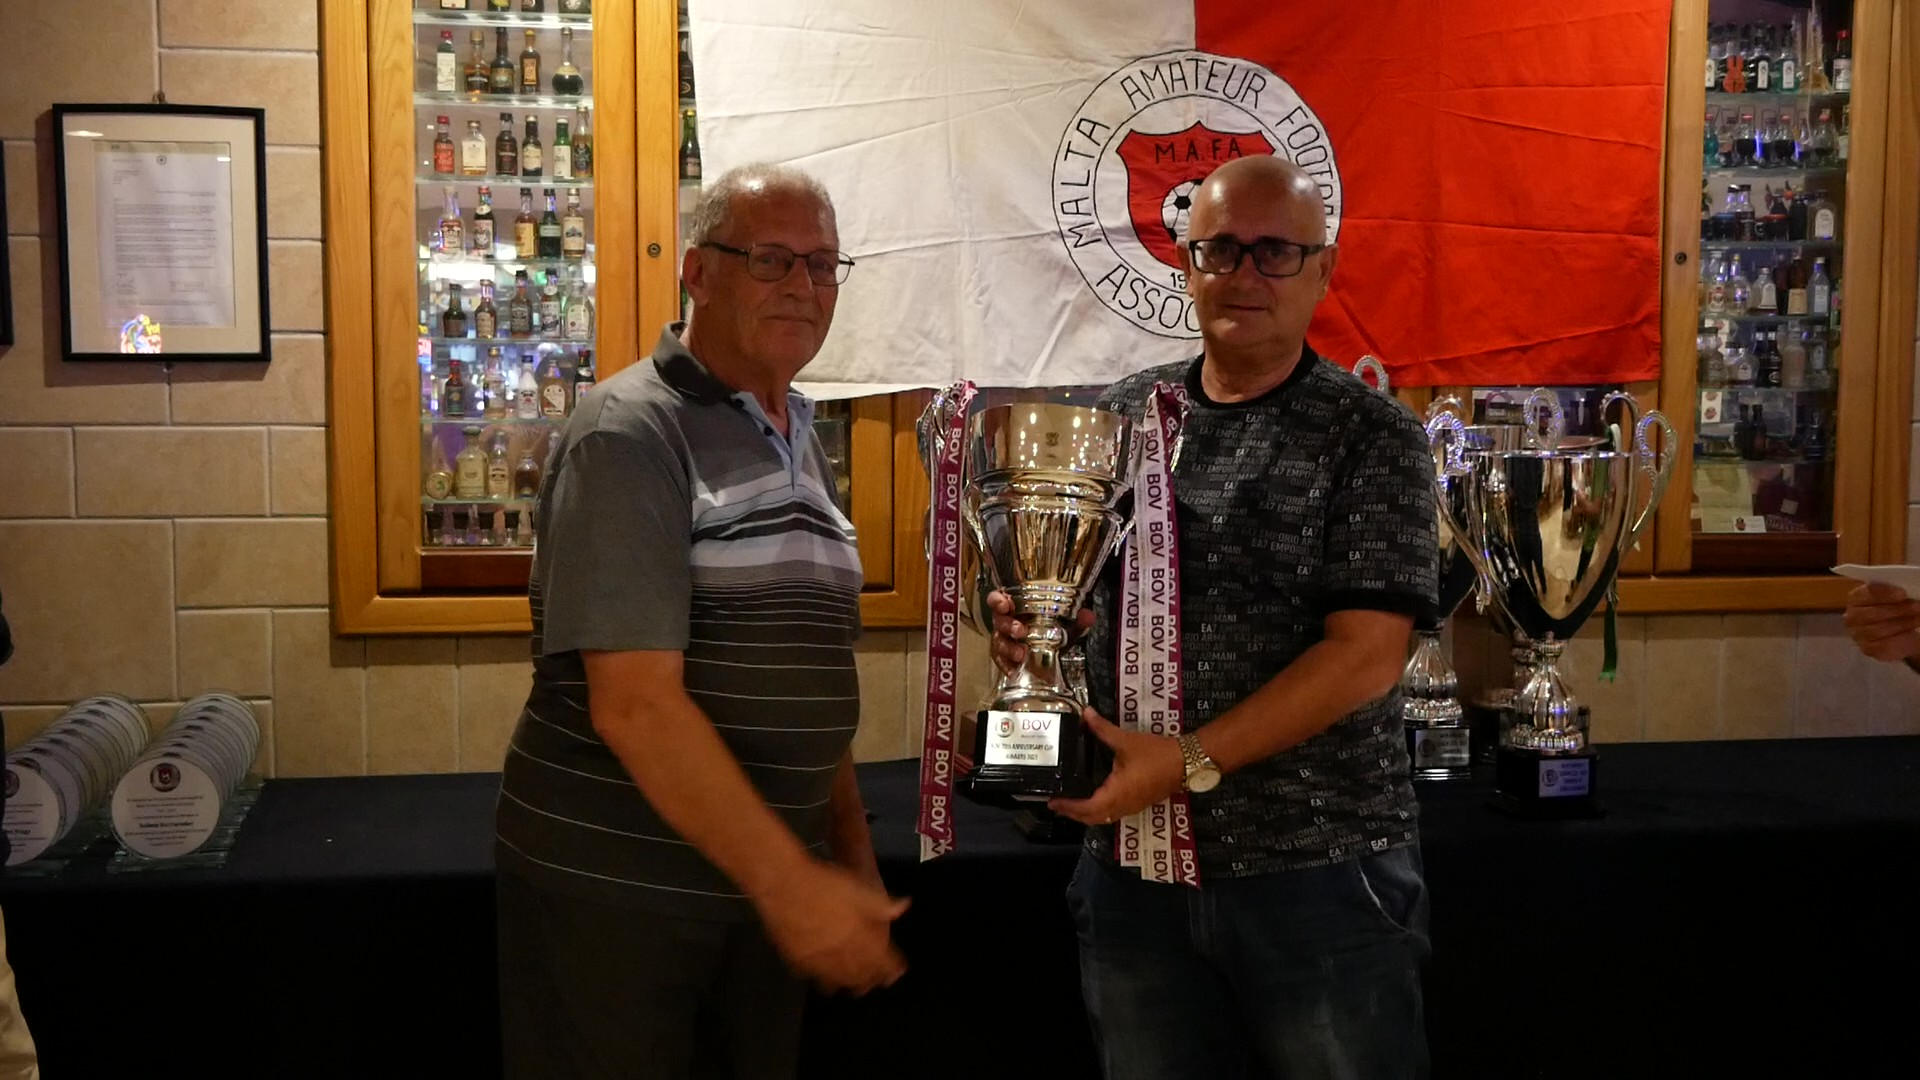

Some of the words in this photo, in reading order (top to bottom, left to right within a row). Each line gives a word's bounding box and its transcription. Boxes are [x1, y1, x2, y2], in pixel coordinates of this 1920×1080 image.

[1061, 118, 1110, 248] MALTA
[1120, 58, 1266, 109] AMATEUR
[950, 428, 962, 464] BOV
[1144, 428, 1160, 463] BOV
[946, 474, 958, 510] BOV
[1147, 474, 1162, 510] BOV
[946, 520, 957, 558] BOV
[1150, 520, 1164, 558] BOV
[943, 566, 956, 604] BOV
[1151, 568, 1165, 605] BOV
[940, 612, 954, 649] BOV
[1151, 615, 1164, 652] BOV
[1125, 638, 1138, 674] BOV
[1198, 661, 1214, 670] EA7
[940, 658, 952, 694] BOV
[1151, 662, 1164, 700] BOV
[938, 704, 951, 740] BOV
[1124, 686, 1138, 722] BOV
[1198, 700, 1214, 710] EA7
[1022, 719, 1052, 730] BOV
[1150, 710, 1164, 737] BO
[936, 750, 949, 786] BOV
[930, 795, 946, 832] BOV
[1152, 804, 1166, 840] BOV
[1174, 803, 1189, 841] BOV
[1124, 824, 1139, 862] BOV
[1371, 838, 1388, 850] EA7
[1154, 850, 1168, 884] BOV
[1180, 849, 1196, 886] BOV
